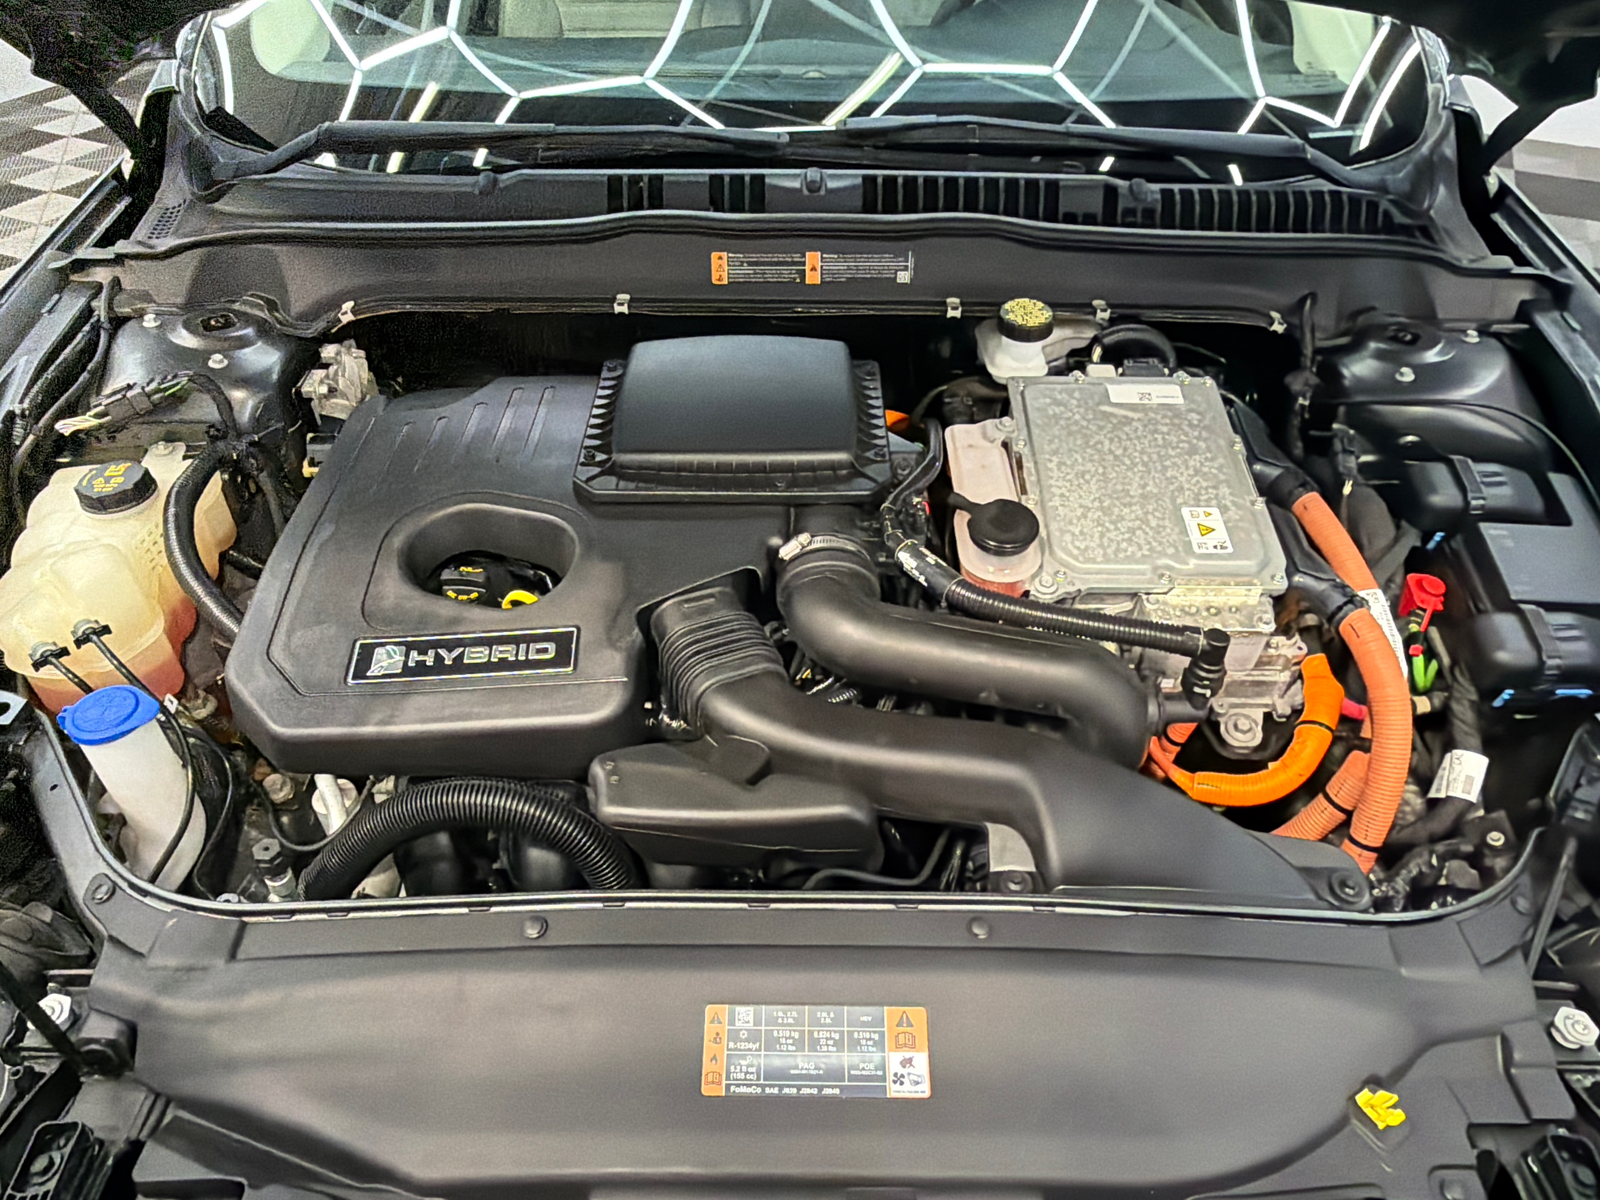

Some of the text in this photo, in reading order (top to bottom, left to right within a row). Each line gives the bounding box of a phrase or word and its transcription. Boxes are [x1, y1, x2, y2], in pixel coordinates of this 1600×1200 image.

[408, 642, 556, 667] HYBRID
[791, 1030, 799, 1039] kg
[831, 1031, 840, 1040] kg
[871, 1032, 879, 1040] kg
[728, 1042, 760, 1051] R-1234yf
